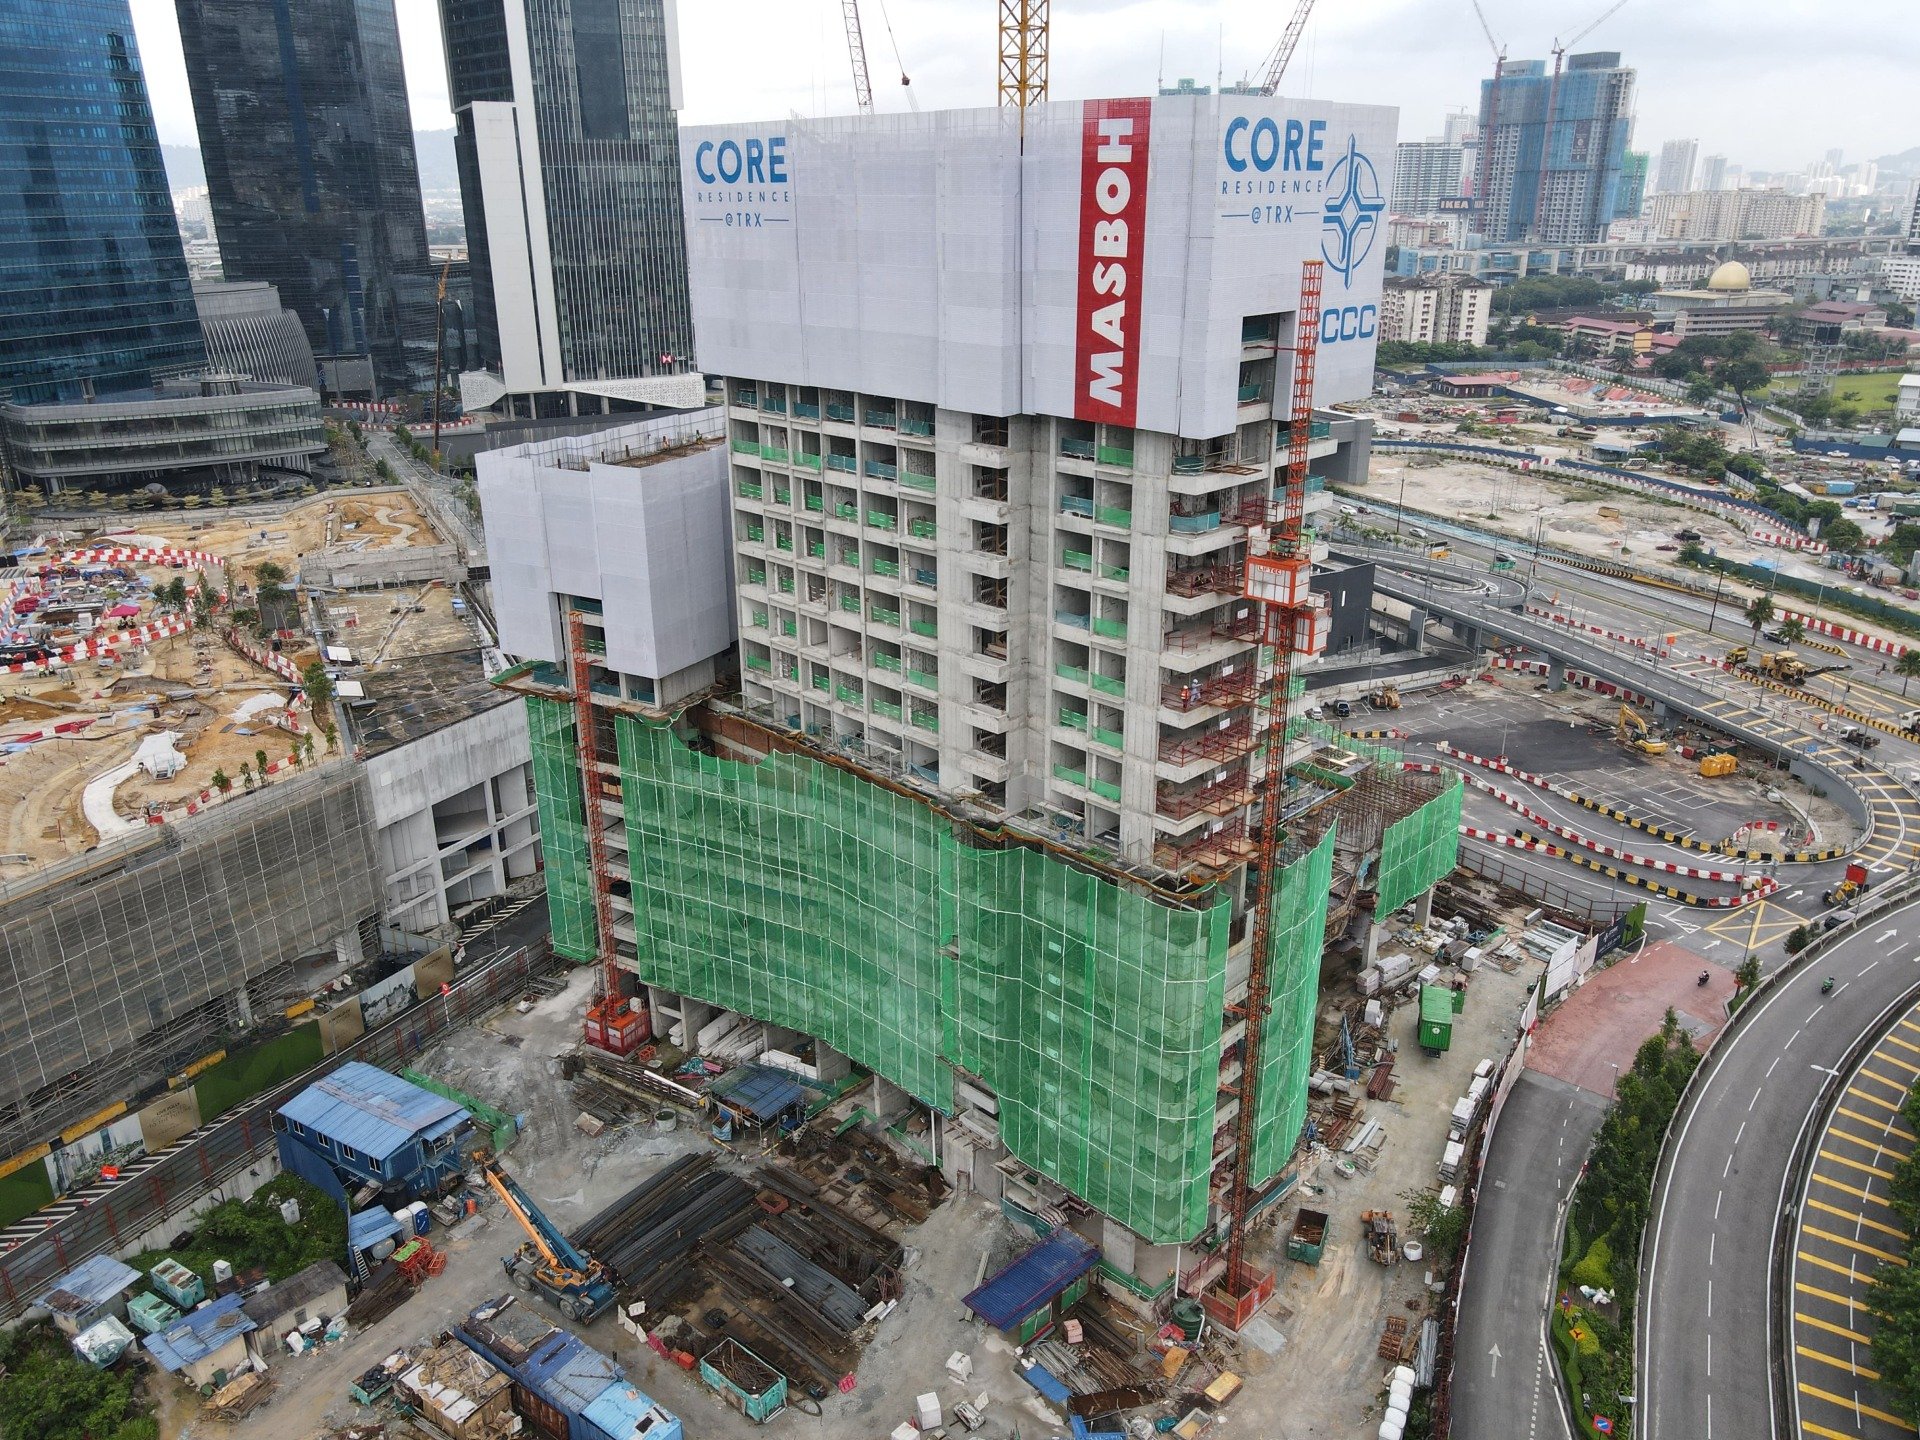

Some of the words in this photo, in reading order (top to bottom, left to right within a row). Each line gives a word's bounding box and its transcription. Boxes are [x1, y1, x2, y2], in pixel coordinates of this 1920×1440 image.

[1224, 116, 1327, 173] CORE
[695, 136, 788, 185] CORE
[698, 190, 789, 203] RESIDENCE
[1222, 179, 1322, 195] RESIDENCE
[1440, 200, 1469, 209] IKEA
[725, 212, 763, 227] @TRX
[1251, 205, 1294, 224] @TRX
[1089, 118, 1134, 408] MASBOH
[1304, 304, 1377, 346] CCC
